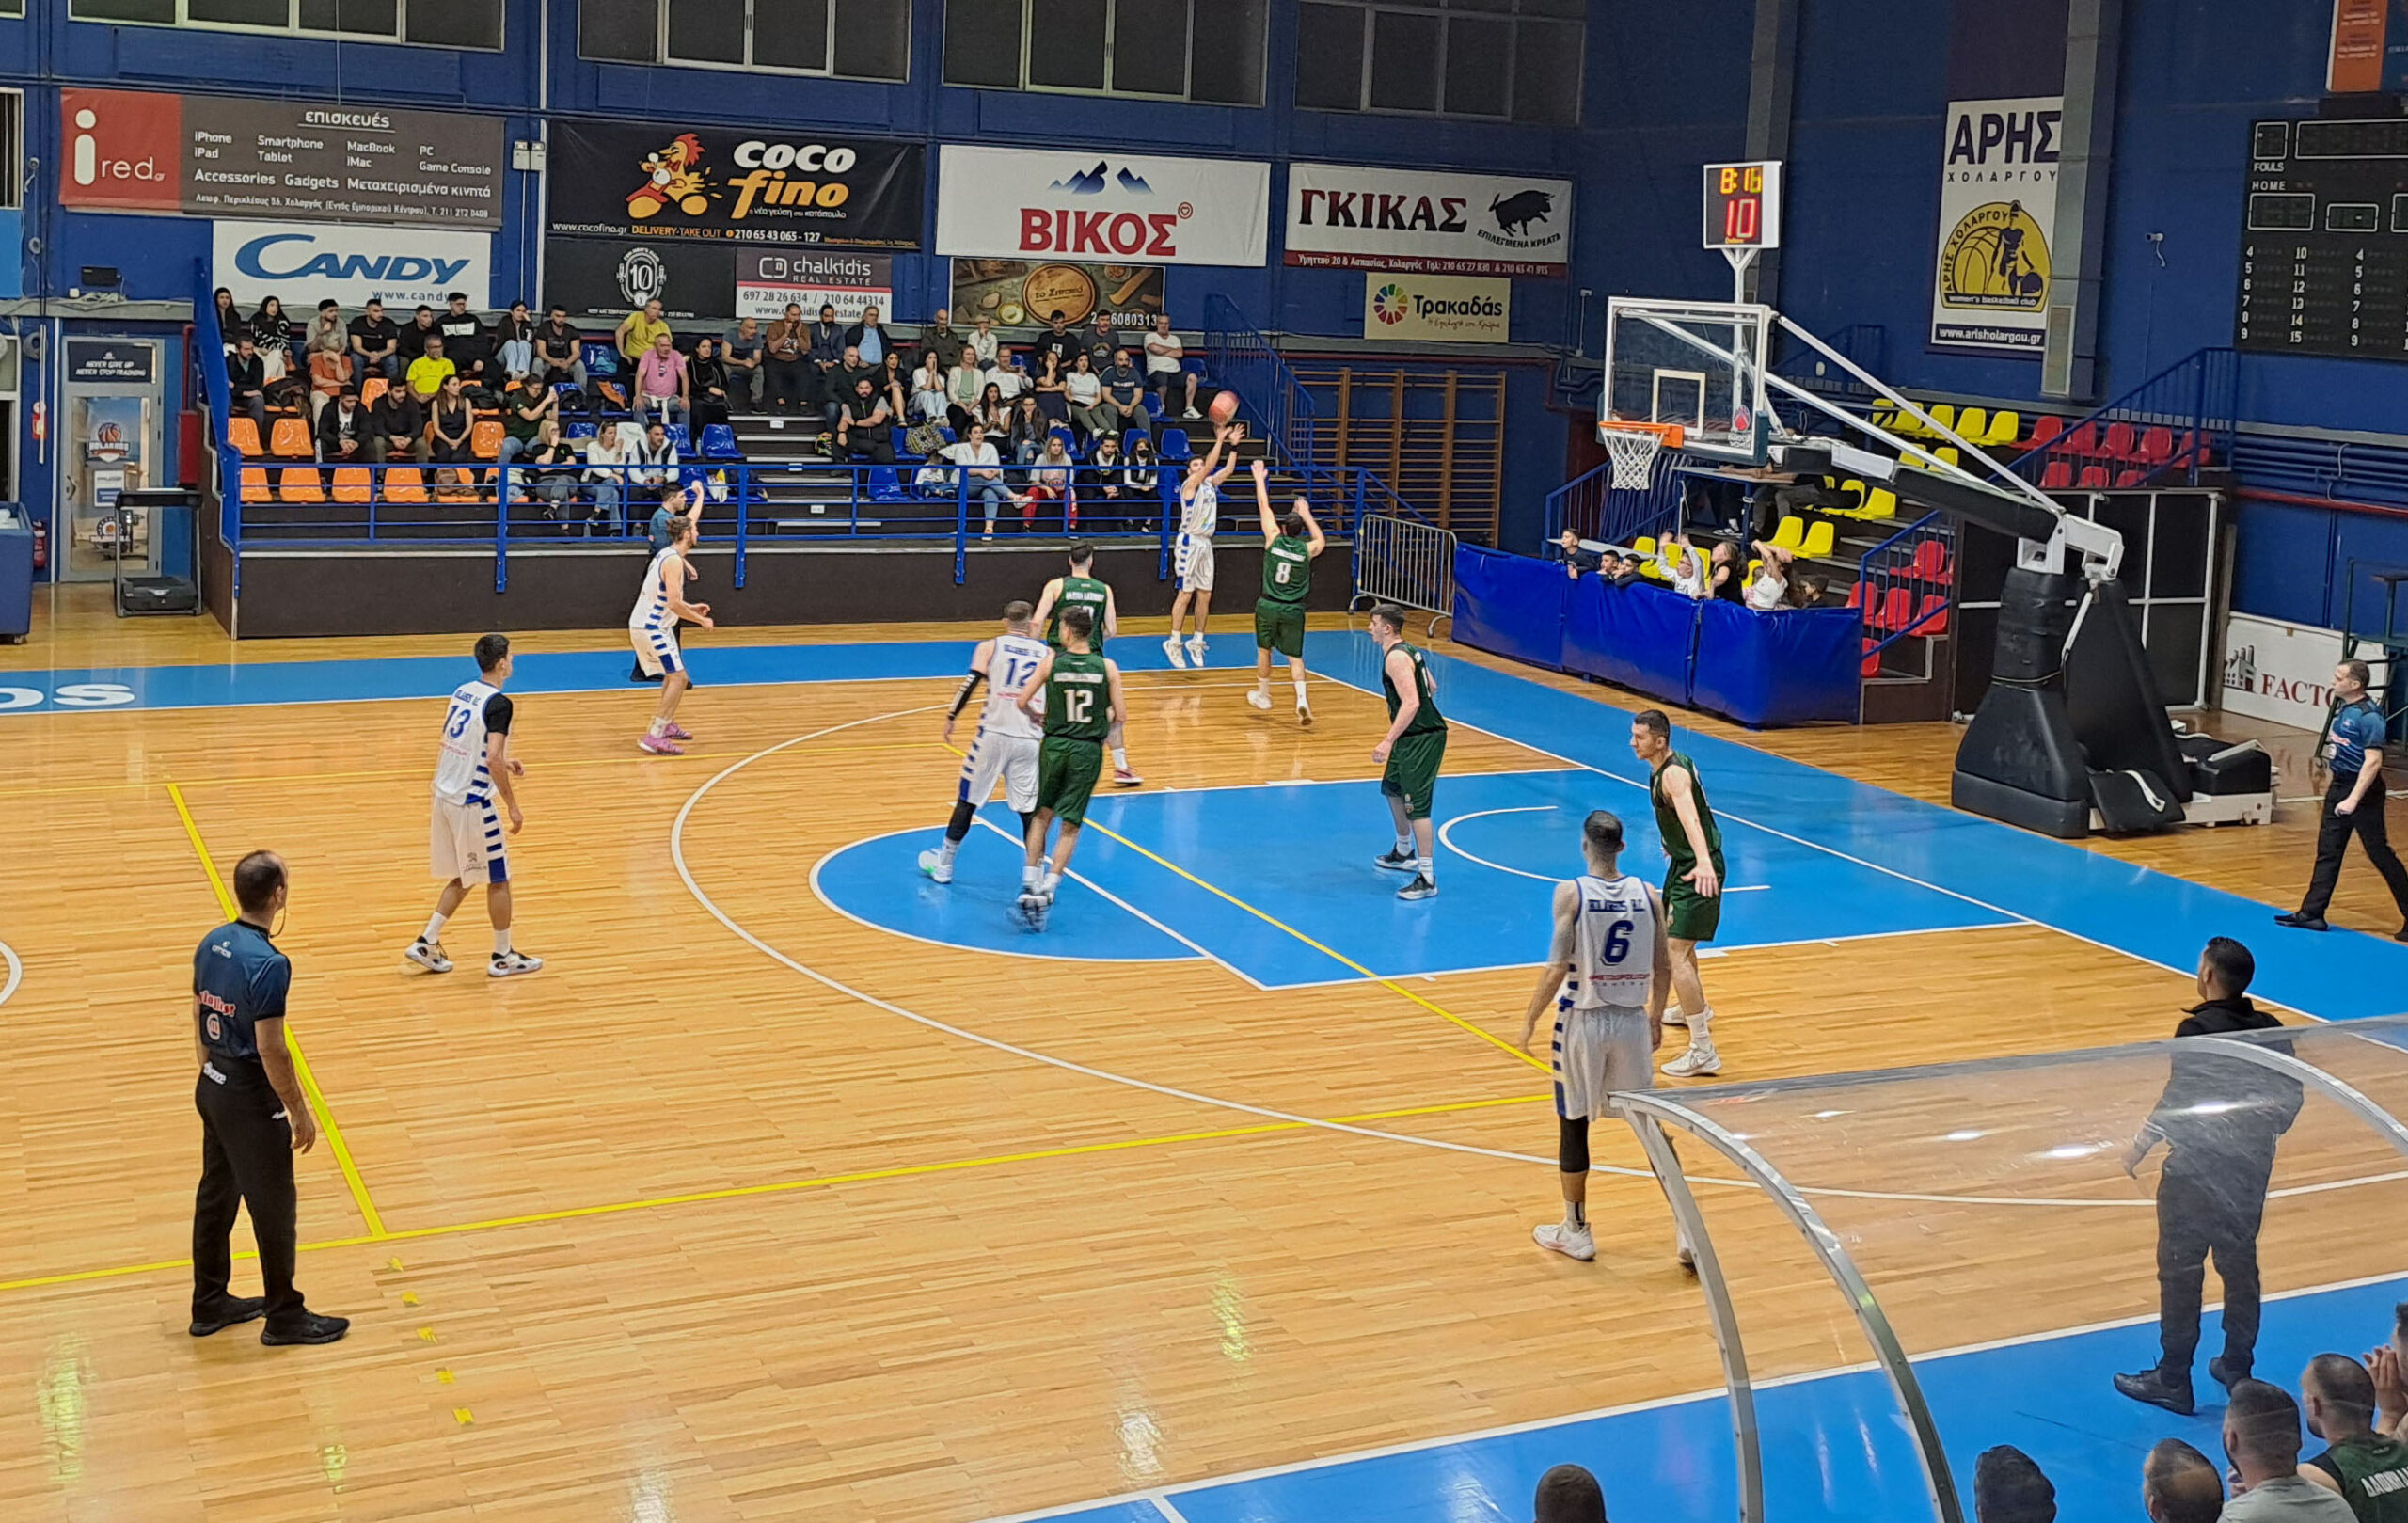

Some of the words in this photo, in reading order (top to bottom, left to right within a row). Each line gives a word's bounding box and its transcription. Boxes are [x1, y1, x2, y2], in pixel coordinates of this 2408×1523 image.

[305, 111, 390, 128] επισκευές
[195, 131, 232, 143] iPhone
[257, 135, 324, 150] Smartphone
[347, 141, 396, 153] MacBook
[419, 146, 434, 156] PC
[1948, 110, 2062, 165] ΑΡΗΣ
[195, 147, 219, 159] iPad
[257, 151, 293, 163] Tablet
[346, 155, 372, 167] iMac
[419, 161, 449, 172] Game
[451, 163, 491, 175] Console
[733, 140, 856, 173] coco
[1947, 171, 2056, 182] ΧΟΛΑΡΓΟΥ
[2254, 163, 2285, 172] FOULS
[194, 168, 276, 185] Accessories
[284, 174, 340, 190] Gadgets
[347, 178, 449, 196] Μεταχειρισμένα
[452, 185, 491, 198] κινητά
[1720, 167, 1763, 194] 8:16
[2252, 181, 2287, 191] HOME
[727, 169, 849, 219] fino
[1299, 189, 1467, 233] ΓΚΙΚΑΣ
[1727, 198, 1756, 238] 10
[552, 222, 626, 235] www.cocofino.gr
[702, 229, 722, 238] OUT
[735, 229, 752, 240] 210
[753, 230, 765, 240] 65
[767, 230, 778, 241] 43
[780, 231, 797, 242] 065
[803, 231, 821, 243] 127
[1019, 208, 1177, 256] ΒΙΚΟΣ
[1530, 232, 1561, 248] ΚΡΕΑΤΑ
[235, 233, 471, 285] CANDY
[1333, 256, 1341, 264] 20
[1943, 253, 1955, 292] ΑΡΗΣ
[1951, 210, 2008, 248] ΧΟΛΑΡΓΟΥ
[2246, 246, 2254, 258] 4
[2295, 247, 2307, 259] 10
[2355, 248, 2364, 261] 4
[793, 256, 871, 276] chalkidis
[2245, 262, 2252, 274] 5
[2294, 264, 2305, 276] 11
[2355, 265, 2363, 278] 5
[793, 276, 820, 284] REAL
[829, 277, 871, 286] ESTATE
[2244, 278, 2251, 290] 6
[2293, 281, 2305, 293] 12
[2354, 283, 2361, 295] 6
[743, 291, 760, 301] 697
[763, 292, 774, 302] 28
[777, 292, 788, 302] 26
[790, 293, 807, 303] 634
[824, 293, 840, 304] 210
[843, 294, 854, 304] 64
[856, 295, 884, 306] 44314
[1413, 294, 1502, 319] Τρακαδάς
[1982, 296, 2020, 306] basketball
[2242, 295, 2250, 307] 7
[2291, 298, 2304, 309] 13
[2353, 301, 2360, 312] 7
[2290, 314, 2303, 326] 14
[2352, 318, 2359, 329] 8
[1939, 328, 2041, 343] www.arisholargou.gr
[2241, 327, 2248, 339] 9
[2289, 331, 2302, 342] 15
[2352, 335, 2358, 347] 9
[1275, 562, 1291, 584] 8
[1006, 658, 1038, 687] 12
[1064, 689, 1094, 723] 12
[443, 705, 471, 738] 13
[1602, 920, 1634, 965] 6
